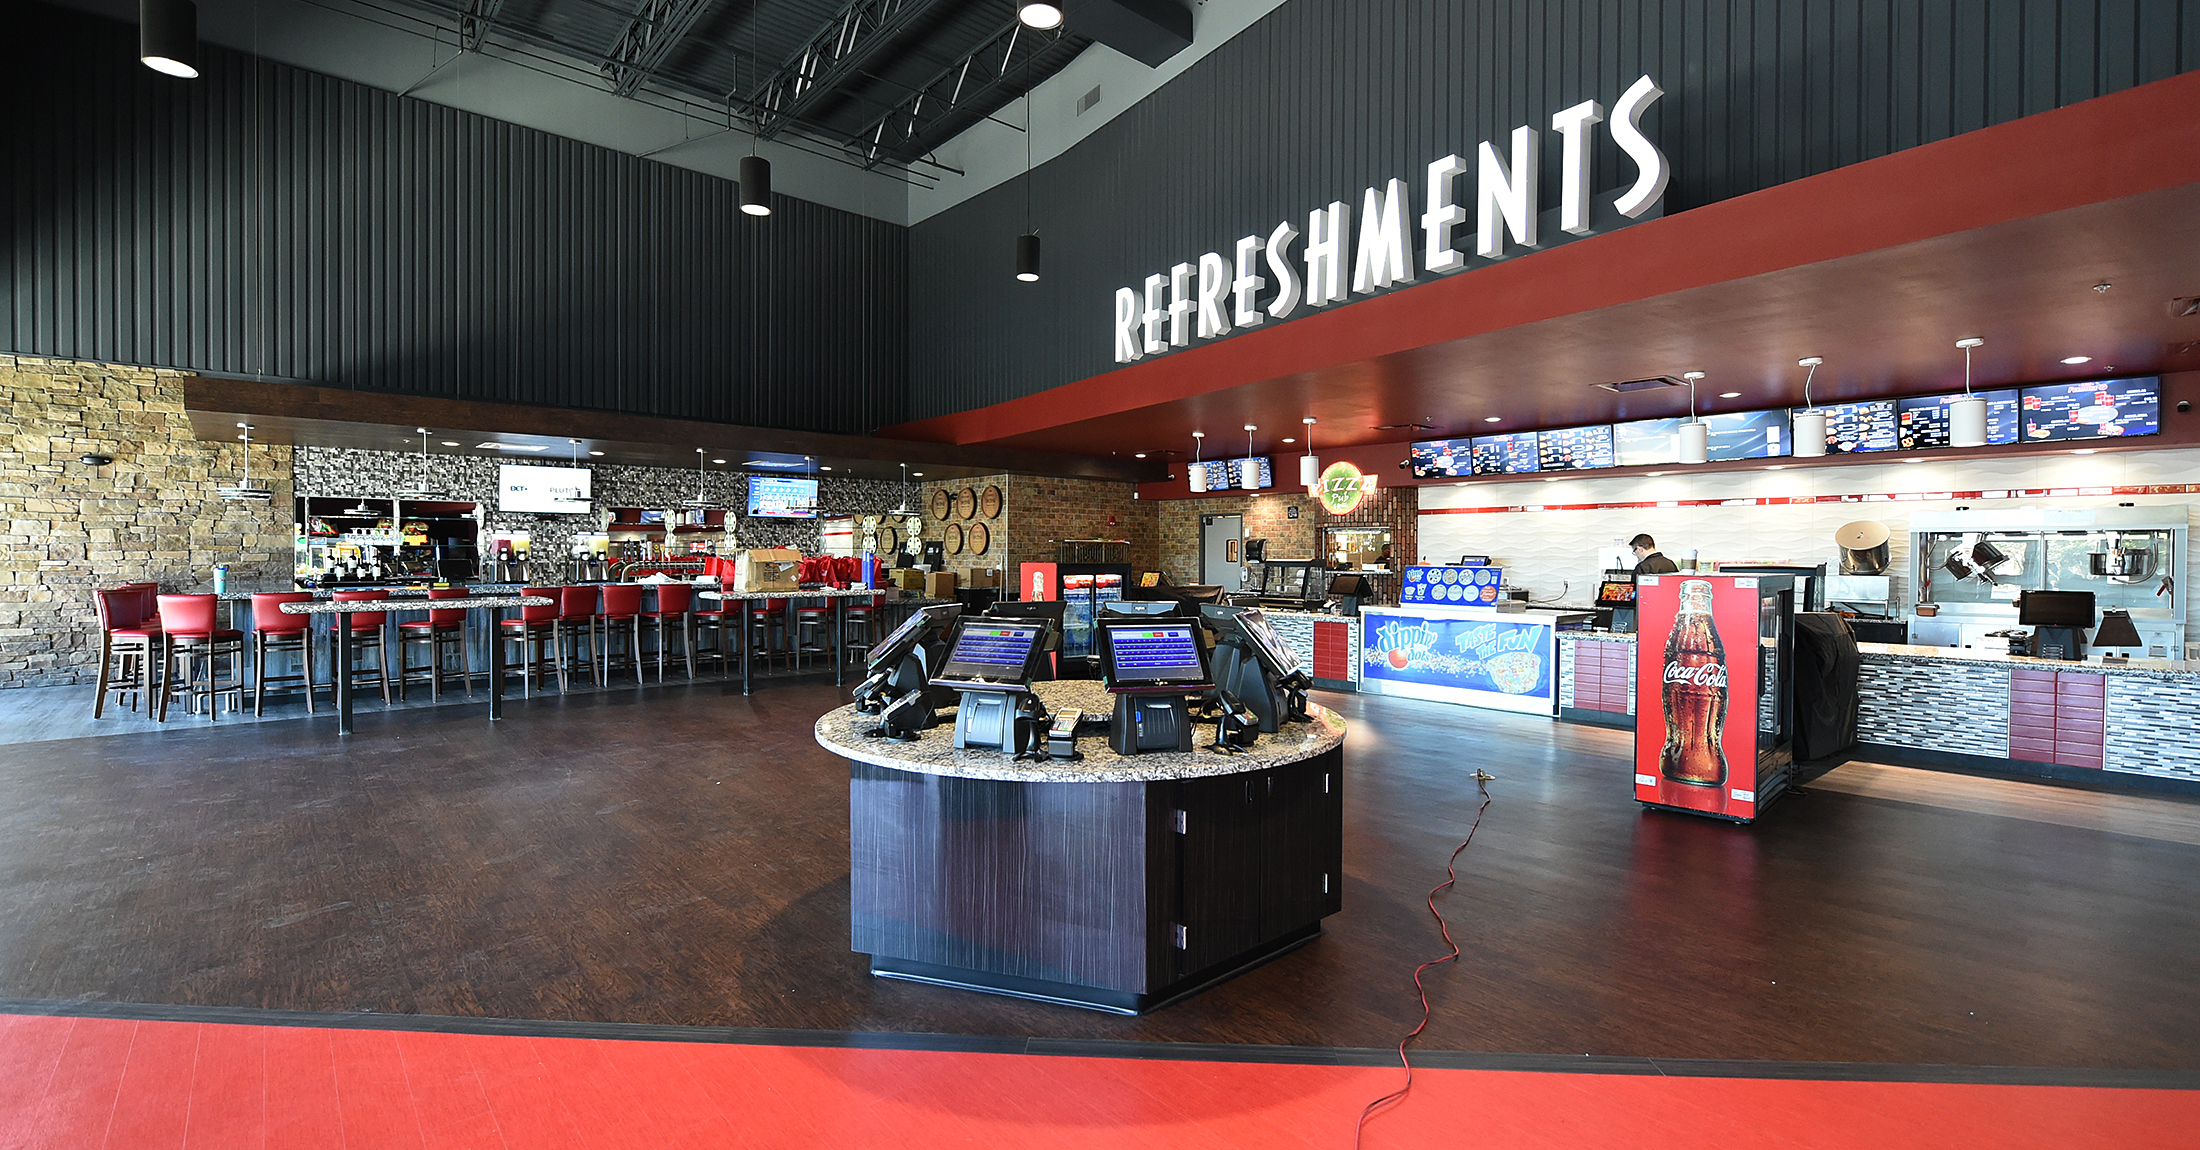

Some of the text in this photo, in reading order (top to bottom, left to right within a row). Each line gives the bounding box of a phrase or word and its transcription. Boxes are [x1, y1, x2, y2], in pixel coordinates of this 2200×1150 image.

[1114, 73, 1670, 364] REFRESHMENTS
[1331, 490, 1350, 504] Pub
[1455, 623, 1497, 653] TASTE
[1476, 639, 1497, 660] THE
[1498, 624, 1544, 653] FUN
[1407, 649, 1430, 662] dots
[1663, 660, 1728, 687] Coca-Cola
